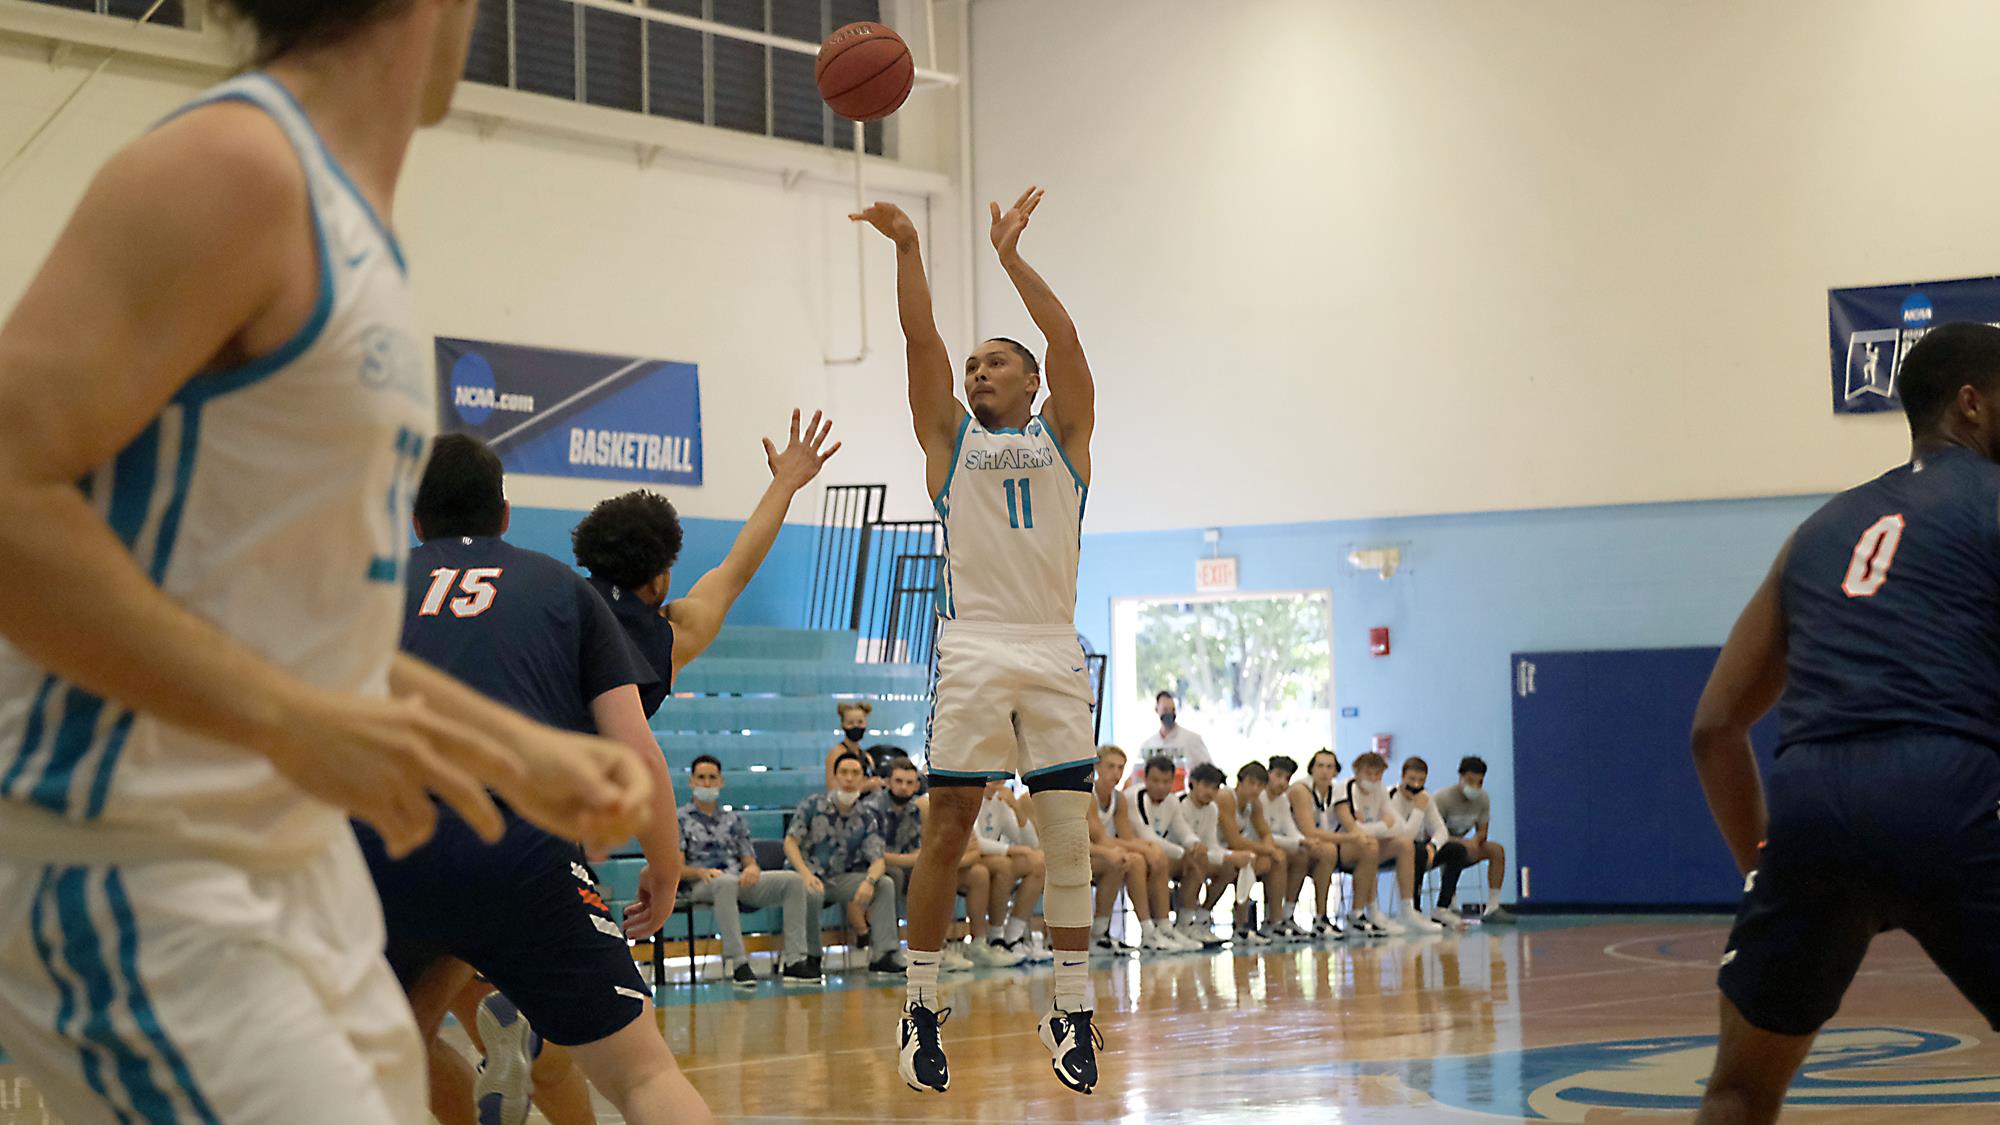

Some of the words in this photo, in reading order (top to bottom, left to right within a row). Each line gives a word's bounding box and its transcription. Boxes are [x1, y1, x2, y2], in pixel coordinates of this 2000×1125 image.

[455, 385, 534, 413] NCAA.com
[569, 426, 694, 473] BASKETBALL
[1003, 478, 1033, 529] 11
[1202, 563, 1228, 586] EXIT
[1841, 513, 1905, 598] 0
[419, 567, 503, 618] 15
